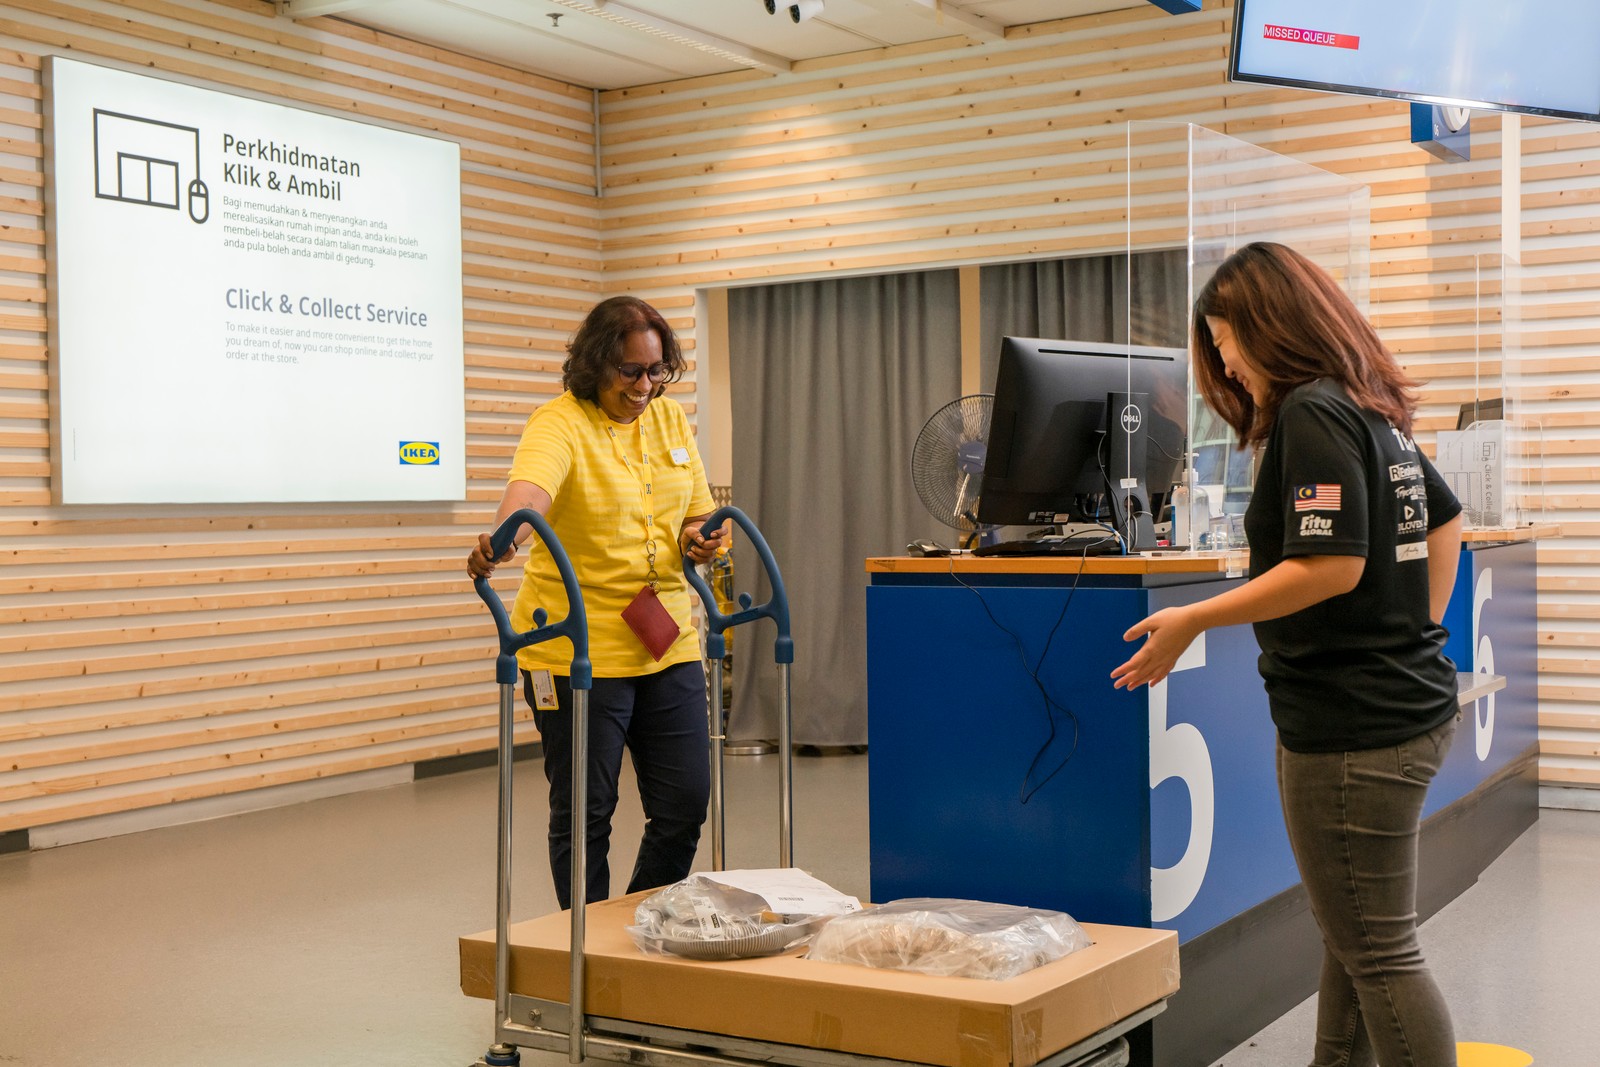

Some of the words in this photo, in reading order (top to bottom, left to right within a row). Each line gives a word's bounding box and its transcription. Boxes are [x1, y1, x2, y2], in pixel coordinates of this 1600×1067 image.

[1264, 26, 1300, 40] MISSED
[1302, 31, 1336, 44] QUEUE
[223, 134, 360, 177] Perkhidmatan
[224, 162, 261, 188] Klik
[267, 170, 281, 192] &
[287, 174, 341, 201] Ambil
[223, 196, 242, 210] Bagi
[244, 200, 300, 216] memudahkan
[302, 208, 308, 218] &
[310, 211, 368, 227] menyenangkan
[370, 220, 388, 230] anda
[223, 211, 284, 227] merealisasikan
[286, 221, 312, 231] rumah
[314, 224, 340, 235] impian
[342, 228, 362, 239] anda,
[365, 232, 382, 241] anda
[385, 234, 397, 243] kini
[399, 235, 419, 247] boleh
[223, 225, 285, 240] membeli-belah
[287, 234, 312, 244] secara
[314, 237, 338, 248] dalam
[340, 241, 360, 251] talian
[362, 244, 397, 256] manakala
[398, 250, 428, 260] pesanan
[224, 239, 244, 248] anda
[247, 241, 265, 252] pula
[267, 243, 289, 255] boleh
[292, 248, 311, 258] anda
[313, 250, 334, 260] ambil
[345, 255, 375, 268] gedung.
[226, 288, 273, 312] Click
[279, 294, 293, 314] &
[299, 296, 361, 320] Collect
[366, 303, 428, 327] Service
[225, 321, 235, 331] To
[238, 324, 260, 334] make
[262, 326, 268, 334] it
[270, 327, 294, 336] easier
[296, 329, 311, 338] and
[313, 331, 333, 340] more
[335, 332, 375, 343] convenient
[377, 336, 384, 344] to
[386, 337, 398, 347] get
[400, 336, 411, 347] the
[413, 338, 432, 348] home
[225, 337, 241, 347] you
[243, 337, 270, 348] dream
[272, 340, 282, 350] of,
[284, 342, 301, 350] now
[303, 343, 317, 353] you
[320, 345, 332, 353] can
[335, 345, 353, 356] shop
[355, 347, 378, 356] online
[379, 349, 392, 358] and
[394, 350, 417, 360] collect
[418, 352, 433, 362] your
[226, 350, 249, 360] order
[251, 352, 259, 361] at
[262, 352, 274, 362] the
[277, 354, 299, 364] store.
[1123, 414, 1139, 422] DELL
[403, 448, 436, 458] IKEA
[1300, 514, 1332, 530] Fitu
[1472, 567, 1496, 762] 6
[1148, 629, 1214, 923] 5
